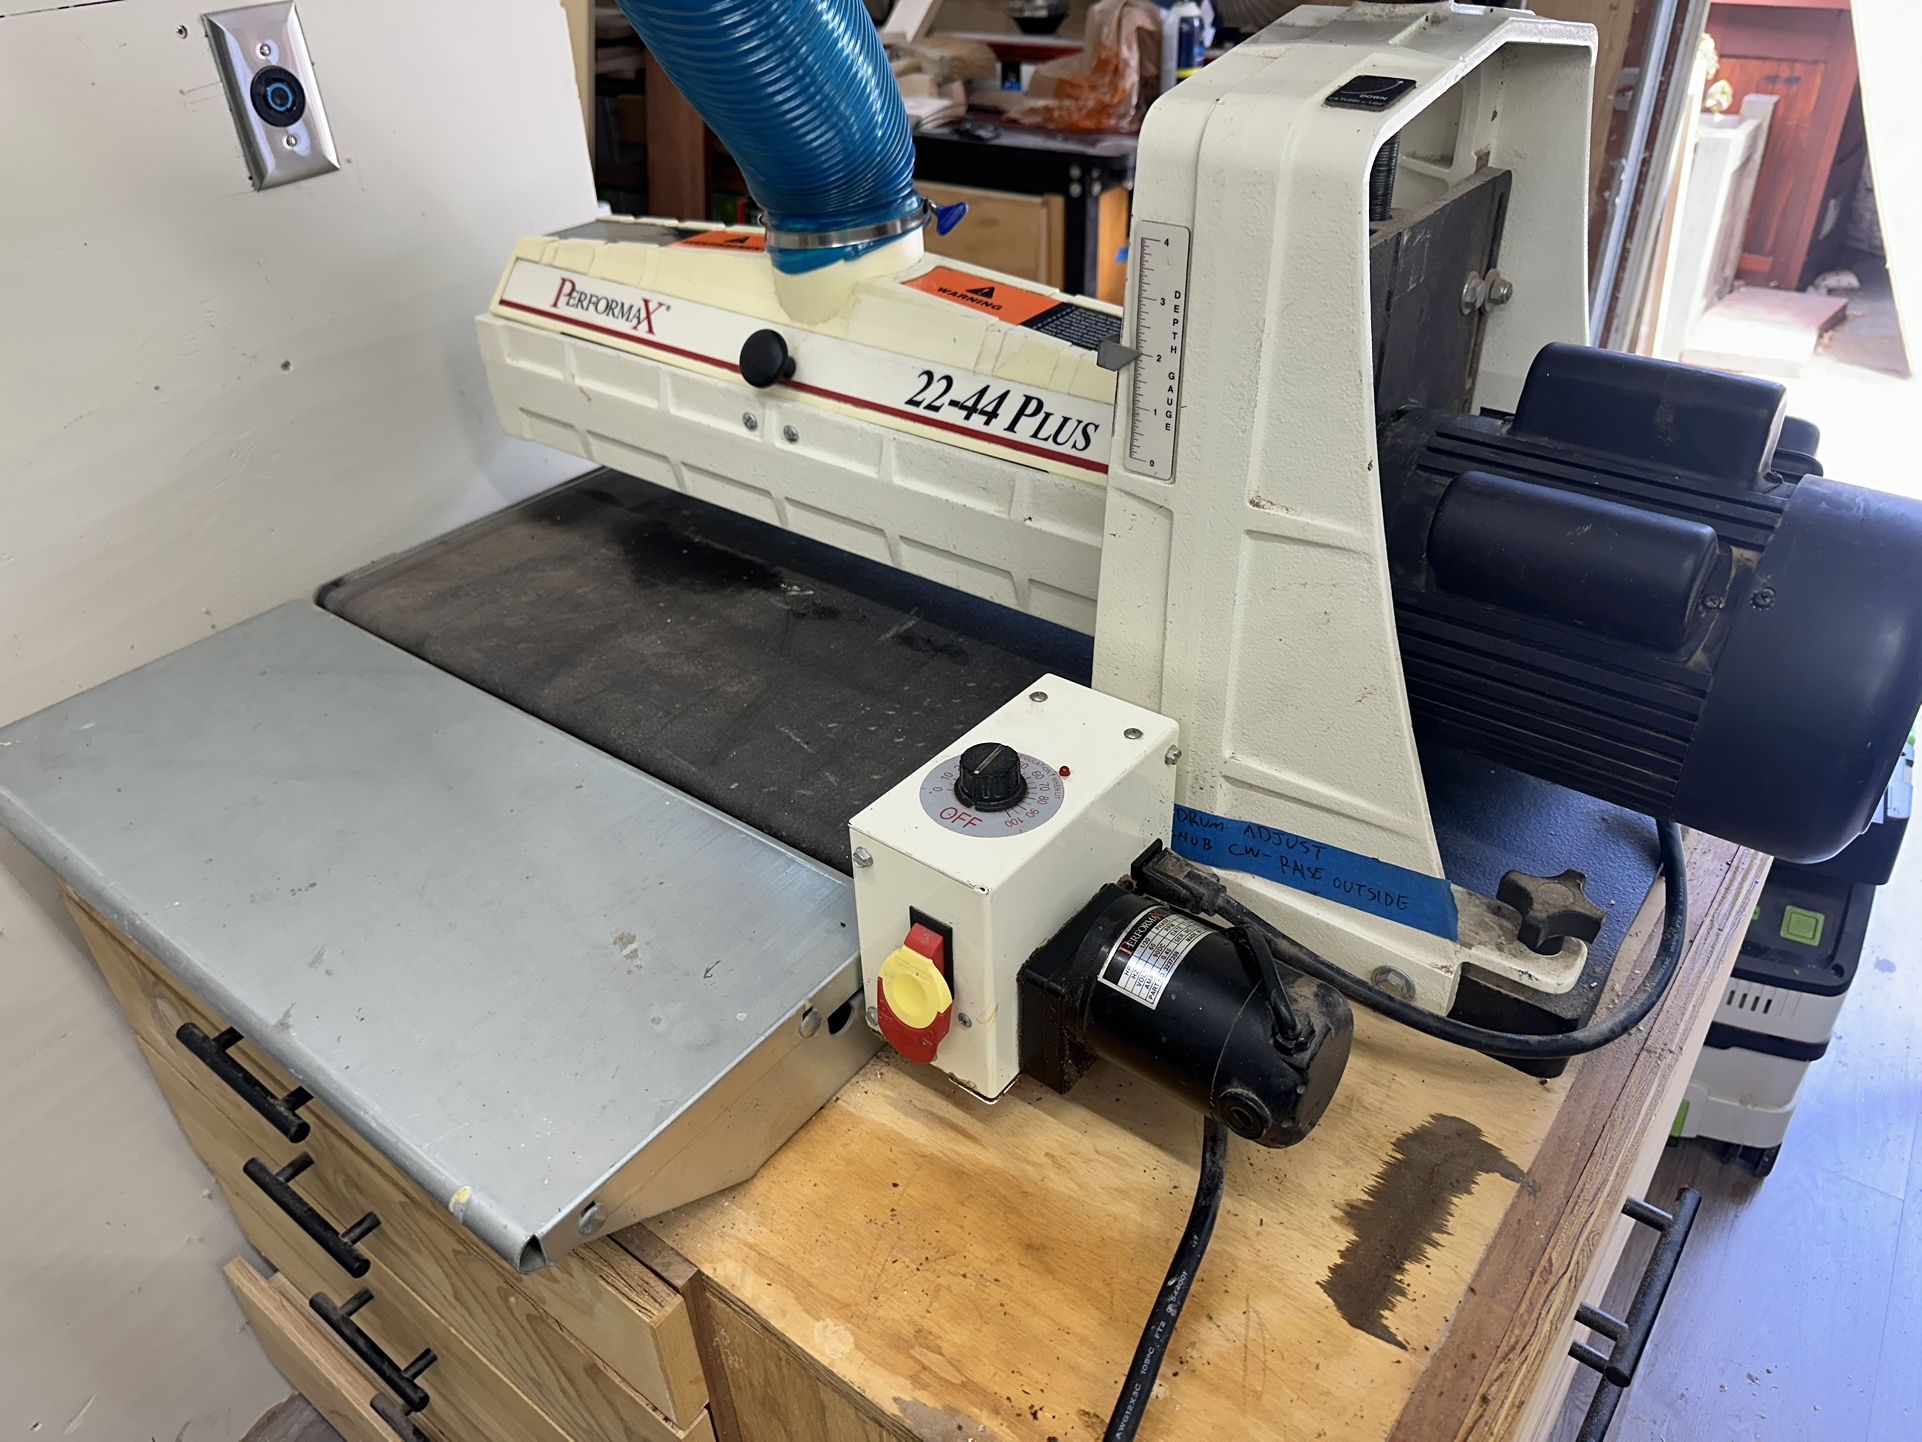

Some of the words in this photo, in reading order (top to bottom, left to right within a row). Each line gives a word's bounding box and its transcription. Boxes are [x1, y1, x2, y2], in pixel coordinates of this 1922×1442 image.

[1360, 93, 1388, 101] DOWN
[1164, 238, 1170, 247] 4
[937, 286, 1003, 312] WARNING
[1160, 297, 1166, 306] 3
[550, 277, 667, 335] PERFORMAX
[1169, 290, 1181, 354] DEPTH
[1156, 354, 1162, 363] 2
[904, 369, 1011, 427] 22-44
[1164, 371, 1176, 432] GAUGE
[1152, 408, 1158, 416] 1
[940, 771, 953, 780] 10
[1031, 770, 1045, 780] 60
[1038, 782, 1051, 792] 70
[1036, 795, 1050, 805] 80
[939, 806, 984, 829] OFF
[1025, 808, 1040, 819] 90
[1004, 816, 1024, 828] 100
[1176, 807, 1225, 833] DRUM
[1243, 824, 1327, 860] ADJUST
[1332, 876, 1409, 911] OUTSIDE
[1148, 982, 1160, 1000] PART
[1115, 1383, 1142, 1440] AWG12X3C
[1154, 1320, 1167, 1340] FT2
